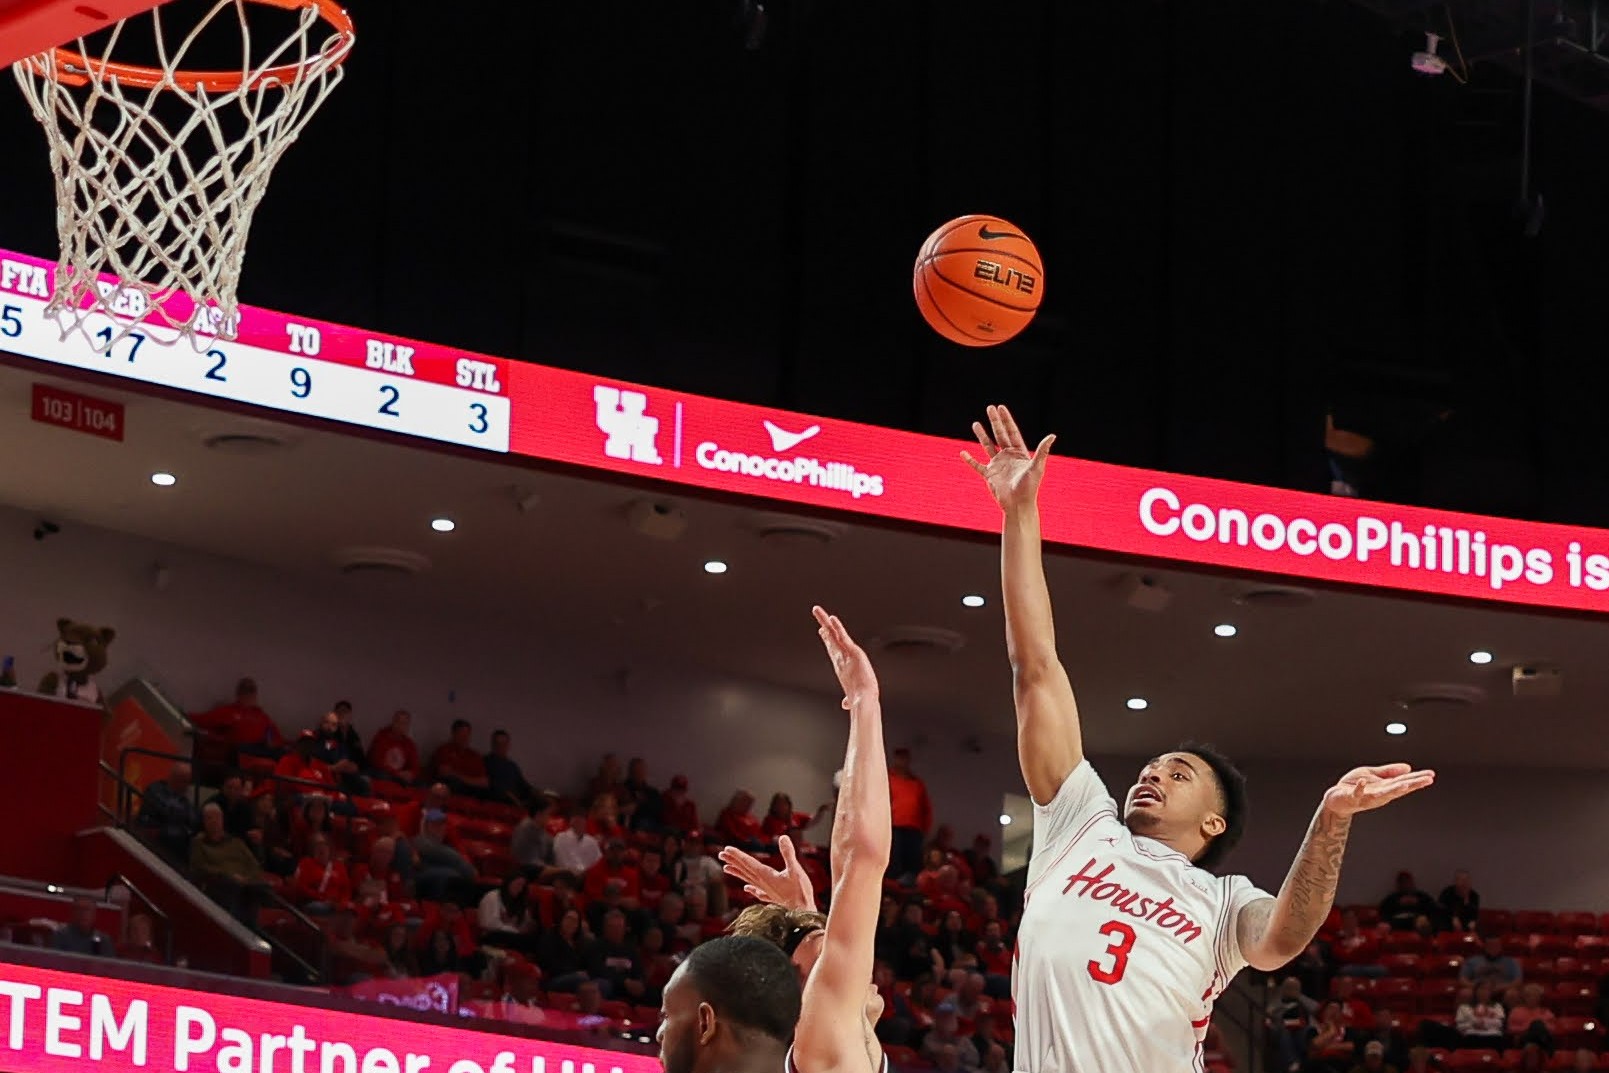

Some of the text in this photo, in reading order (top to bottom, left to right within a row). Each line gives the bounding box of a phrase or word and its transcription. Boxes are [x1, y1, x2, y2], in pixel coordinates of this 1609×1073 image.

[974, 258, 1036, 295] ELITE
[1, 258, 49, 297] FTA
[286, 322, 321, 356] TO
[366, 339, 415, 376] BLK
[456, 358, 501, 393] STL
[0, 304, 489, 434] 5 17 2 9 2 3
[43, 396, 116, 432] 103 104
[695, 442, 884, 499] ConocoPhillips
[1139, 487, 1609, 591] ConocoPhillips is
[1062, 857, 1202, 944] Houston
[1087, 919, 1137, 986] 3
